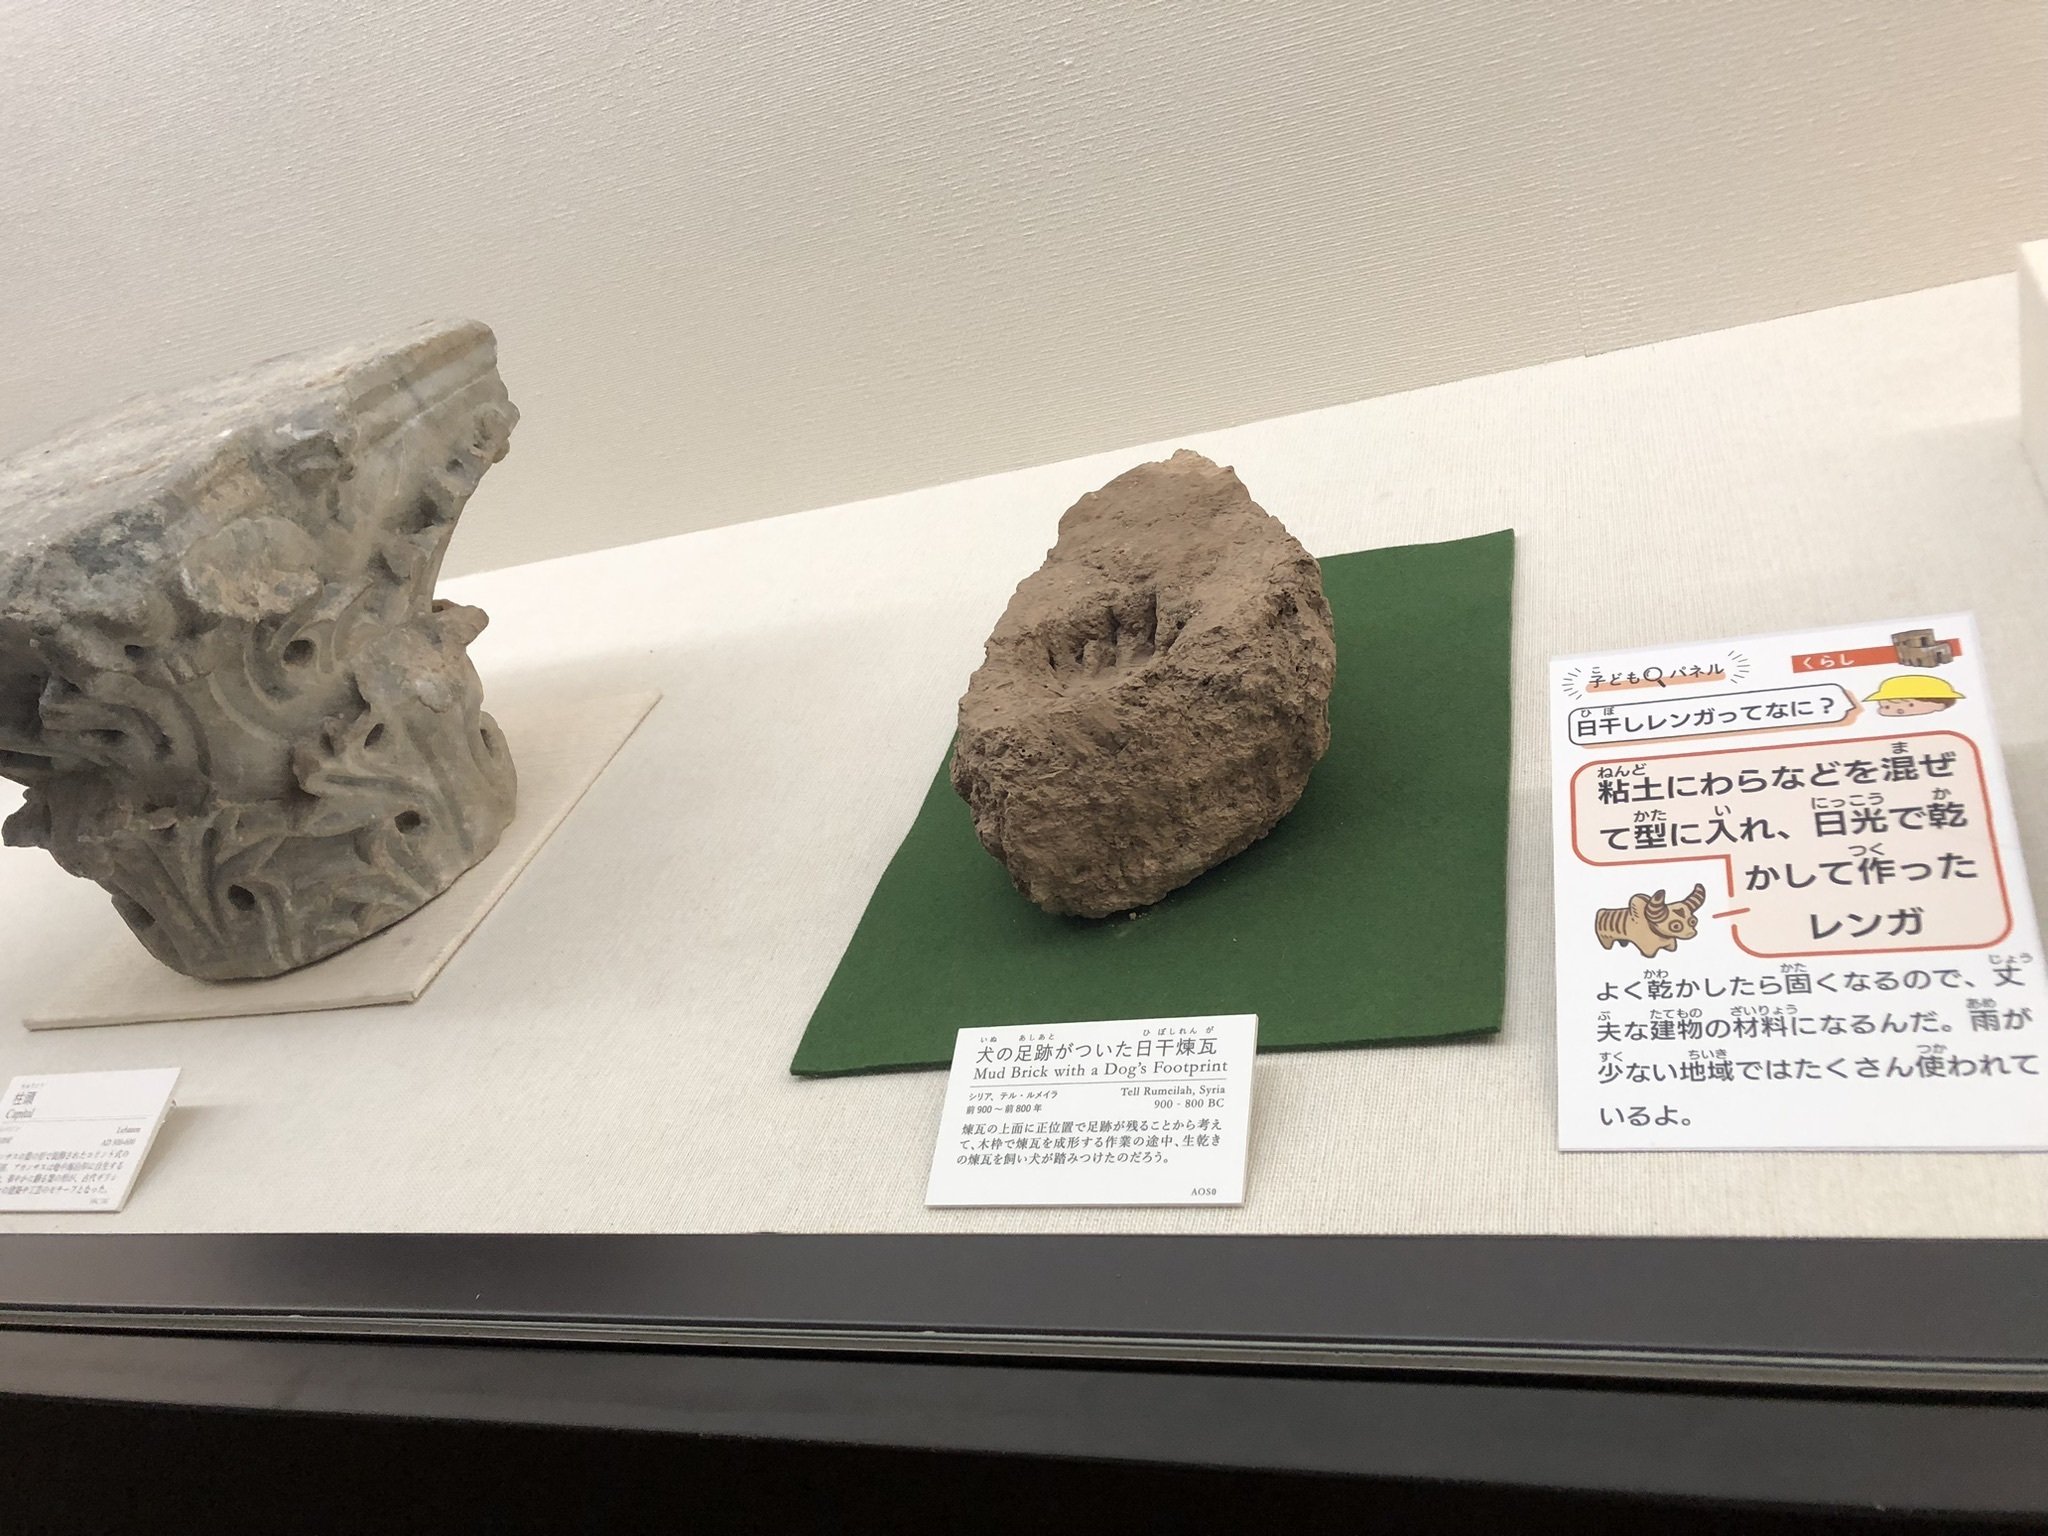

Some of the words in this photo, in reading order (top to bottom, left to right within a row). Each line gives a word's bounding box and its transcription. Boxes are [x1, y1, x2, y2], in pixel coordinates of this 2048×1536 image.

[1802, 653, 1856, 670] くらし
[1577, 697, 1834, 737] 日干しレンガってなに？
[1597, 762, 1647, 778] ねんど
[1891, 742, 1908, 754] ま
[1598, 752, 1957, 805] 粘土にわらなどを混ぜ
[1634, 809, 1666, 822] かた
[1715, 805, 1731, 816] い
[1812, 793, 1884, 811] にっこう
[1932, 788, 1951, 800] か
[1848, 843, 1884, 858] つく
[1746, 850, 1977, 890] かして作った
[1811, 907, 1923, 939] レンガ
[1644, 969, 1668, 981] かわ
[1780, 963, 1808, 975] かた
[1989, 953, 2033, 965] じょう
[1597, 966, 2025, 1002] よく乾かしたら固くなるので、丈
[1598, 1011, 1610, 1021] ぶ
[1650, 1008, 1702, 1021] たてもの
[1730, 1004, 1797, 1018] ざいりょう
[1967, 999, 1995, 1009] あめ
[1019, 1033, 1054, 1041] あしあと
[1598, 1007, 2032, 1042] 夫な建物の材料になるんだ。雨が
[977, 1038, 1217, 1063] 犬の足跡がついた日干煉瓦
[1600, 1052, 1622, 1064] すく
[1688, 1049, 1727, 1061] ちいき
[1917, 1044, 1947, 1056] つか
[974, 1067, 1005, 1079] Mud
[1011, 1065, 1048, 1078] Brick
[1055, 1064, 1084, 1076] with
[1105, 1062, 1146, 1078] Dog’s
[1154, 1059, 1227, 1076] Footprint
[1598, 1054, 2038, 1084] 少ない地域ではたくさん使われて
[1121, 1087, 1139, 1096] Tell
[1144, 1086, 1195, 1095] Rumeilah,
[1199, 1085, 1225, 1096] Syria
[1155, 1100, 1173, 1108] 900
[1185, 1099, 1204, 1108] 800
[1208, 1099, 1224, 1107] BC
[1601, 1105, 1690, 1126] いるよ。
